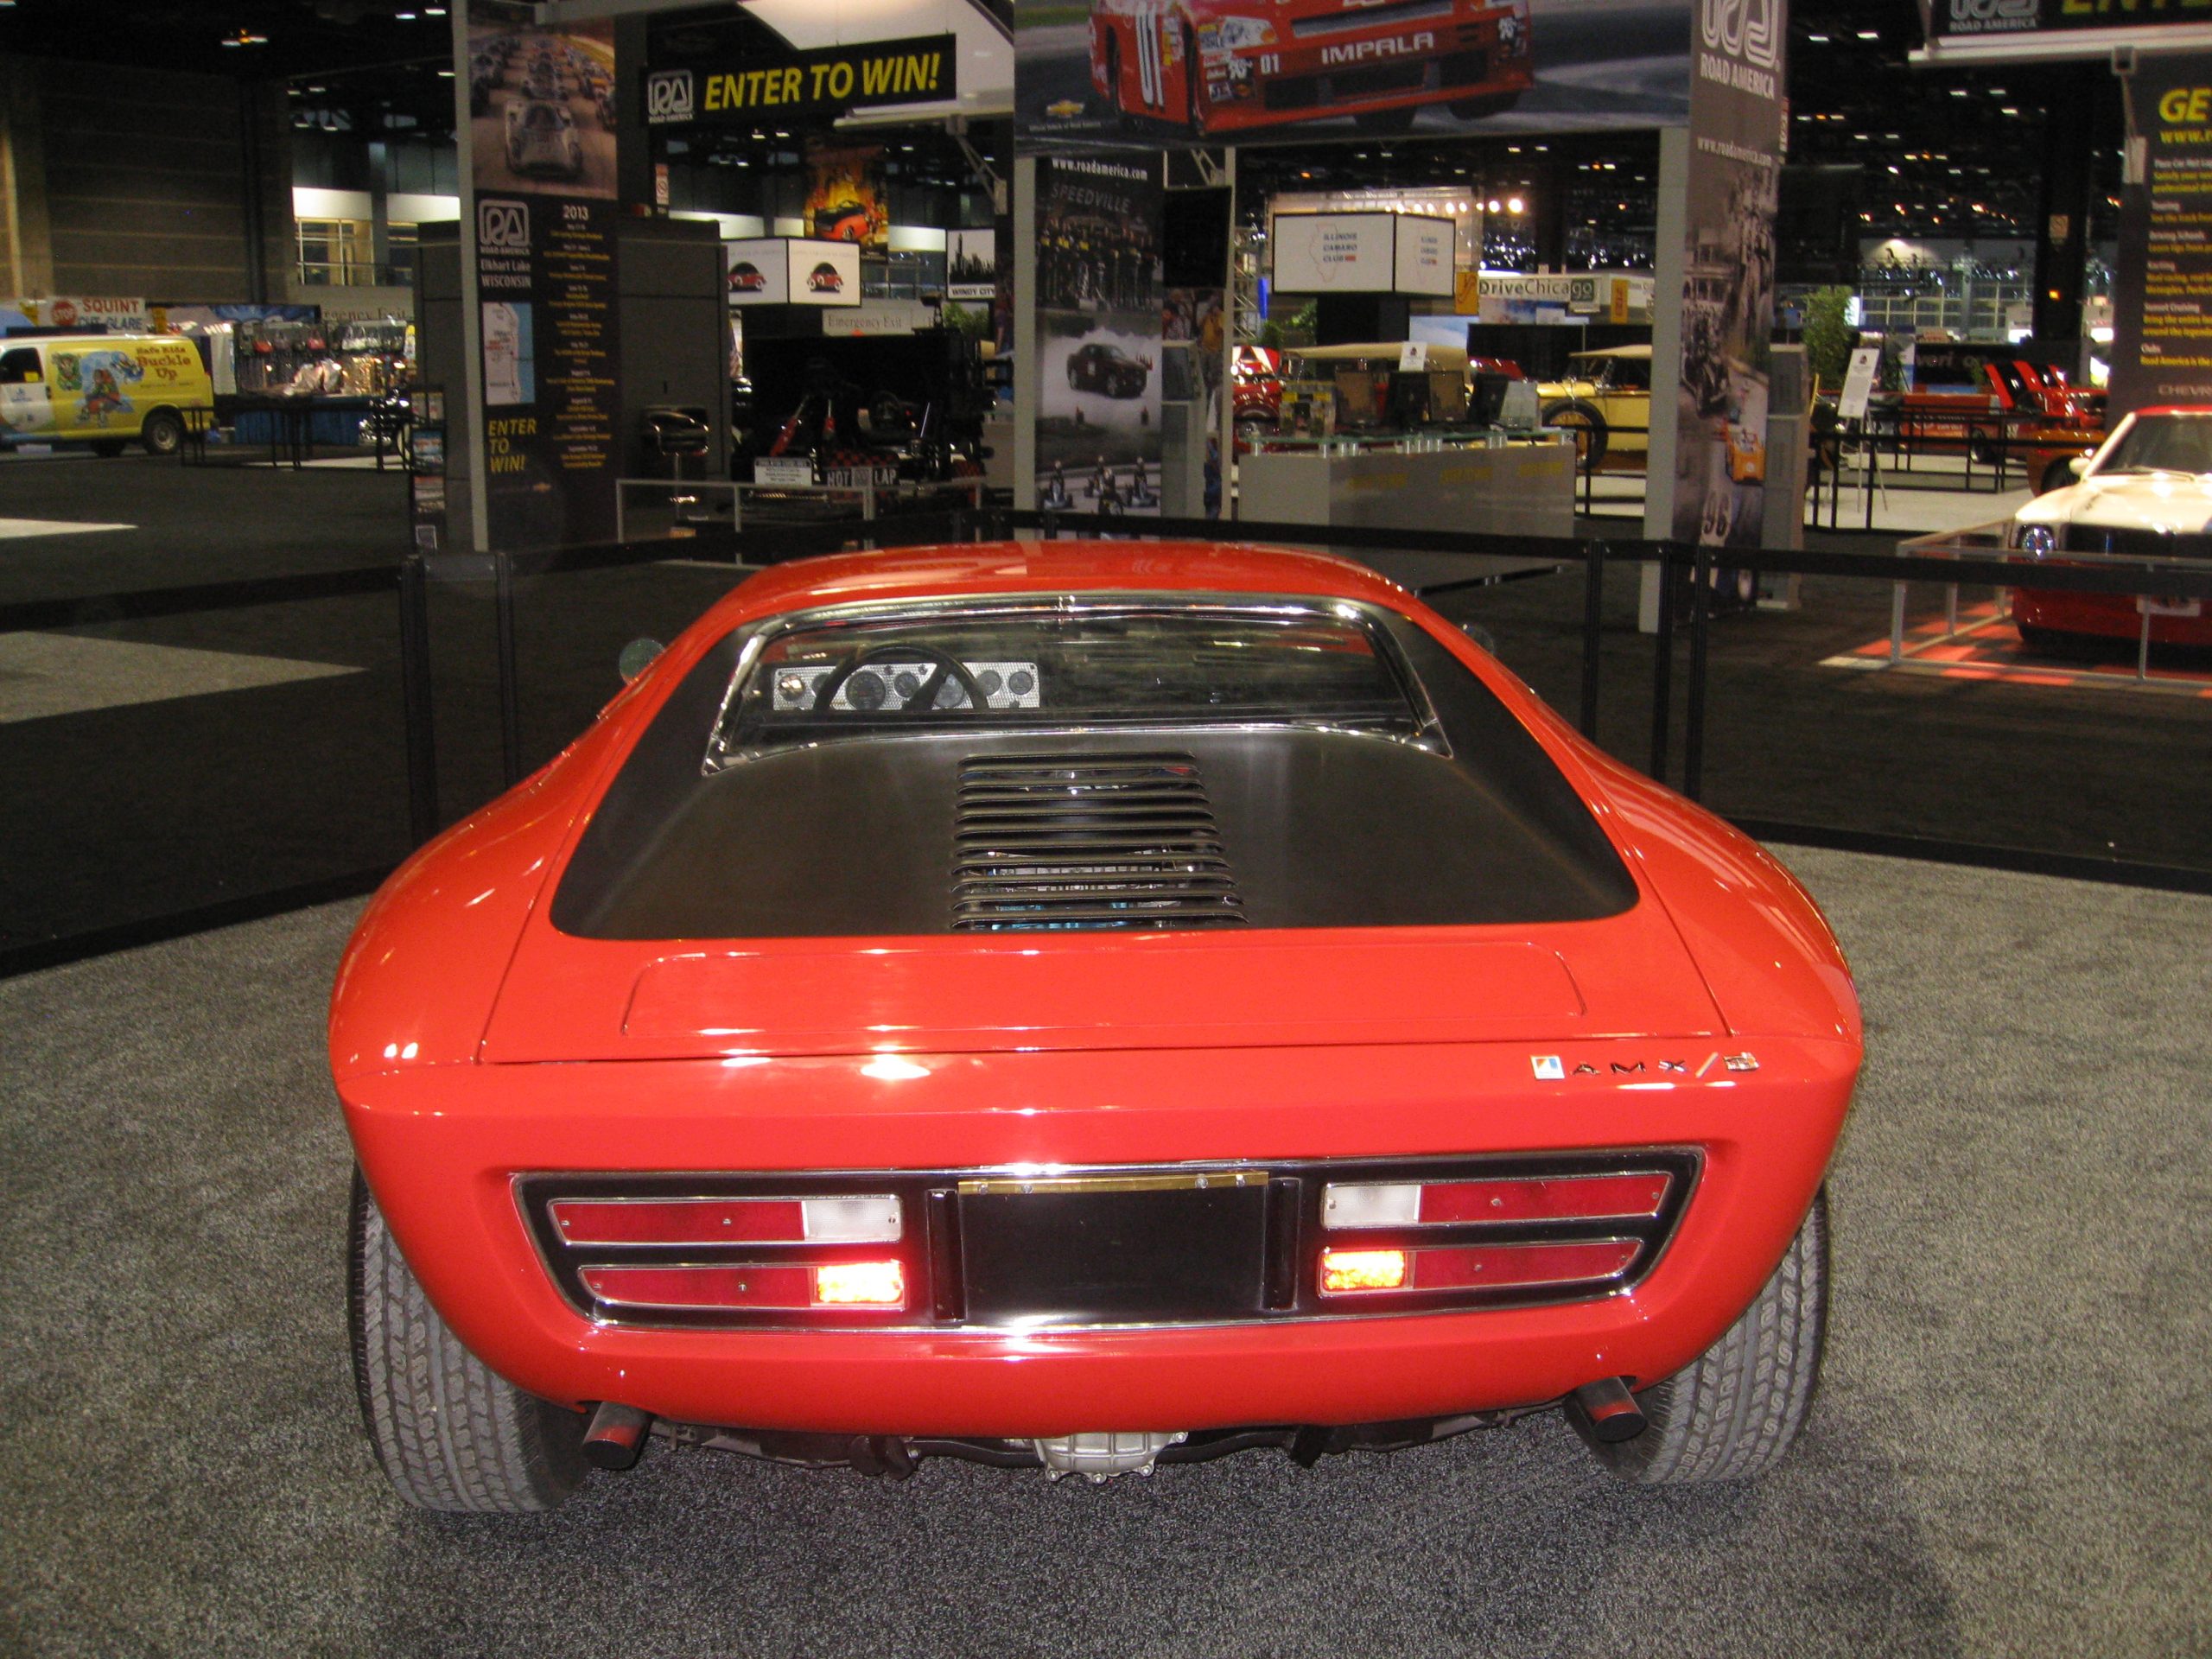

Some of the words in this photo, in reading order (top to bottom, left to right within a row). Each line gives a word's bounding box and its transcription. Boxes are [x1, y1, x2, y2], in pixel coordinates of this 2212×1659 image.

[1321, 32, 1434, 65] IMPALA
[1260, 54, 1280, 75] 01
[1700, 53, 1730, 85] ROAD
[703, 67, 804, 111] ENTER
[810, 61, 855, 100] TO
[863, 52, 941, 96] WIN!
[1052, 157, 1148, 181] www.roadamerica.com
[1051, 182, 1132, 213] SPEEDVILLE
[563, 205, 589, 221] 2013
[481, 274, 531, 289] WISCONSIN
[1478, 279, 1593, 299] DriveChicago
[82, 297, 139, 314] SQUINT
[829, 315, 880, 328] Emergency
[883, 315, 902, 327] Exit
[136, 355, 191, 367] Buckle
[155, 367, 177, 380] Up
[488, 417, 537, 435] ENTER
[490, 438, 509, 454] TO
[490, 454, 526, 474] WIN!
[874, 467, 897, 486] LAP
